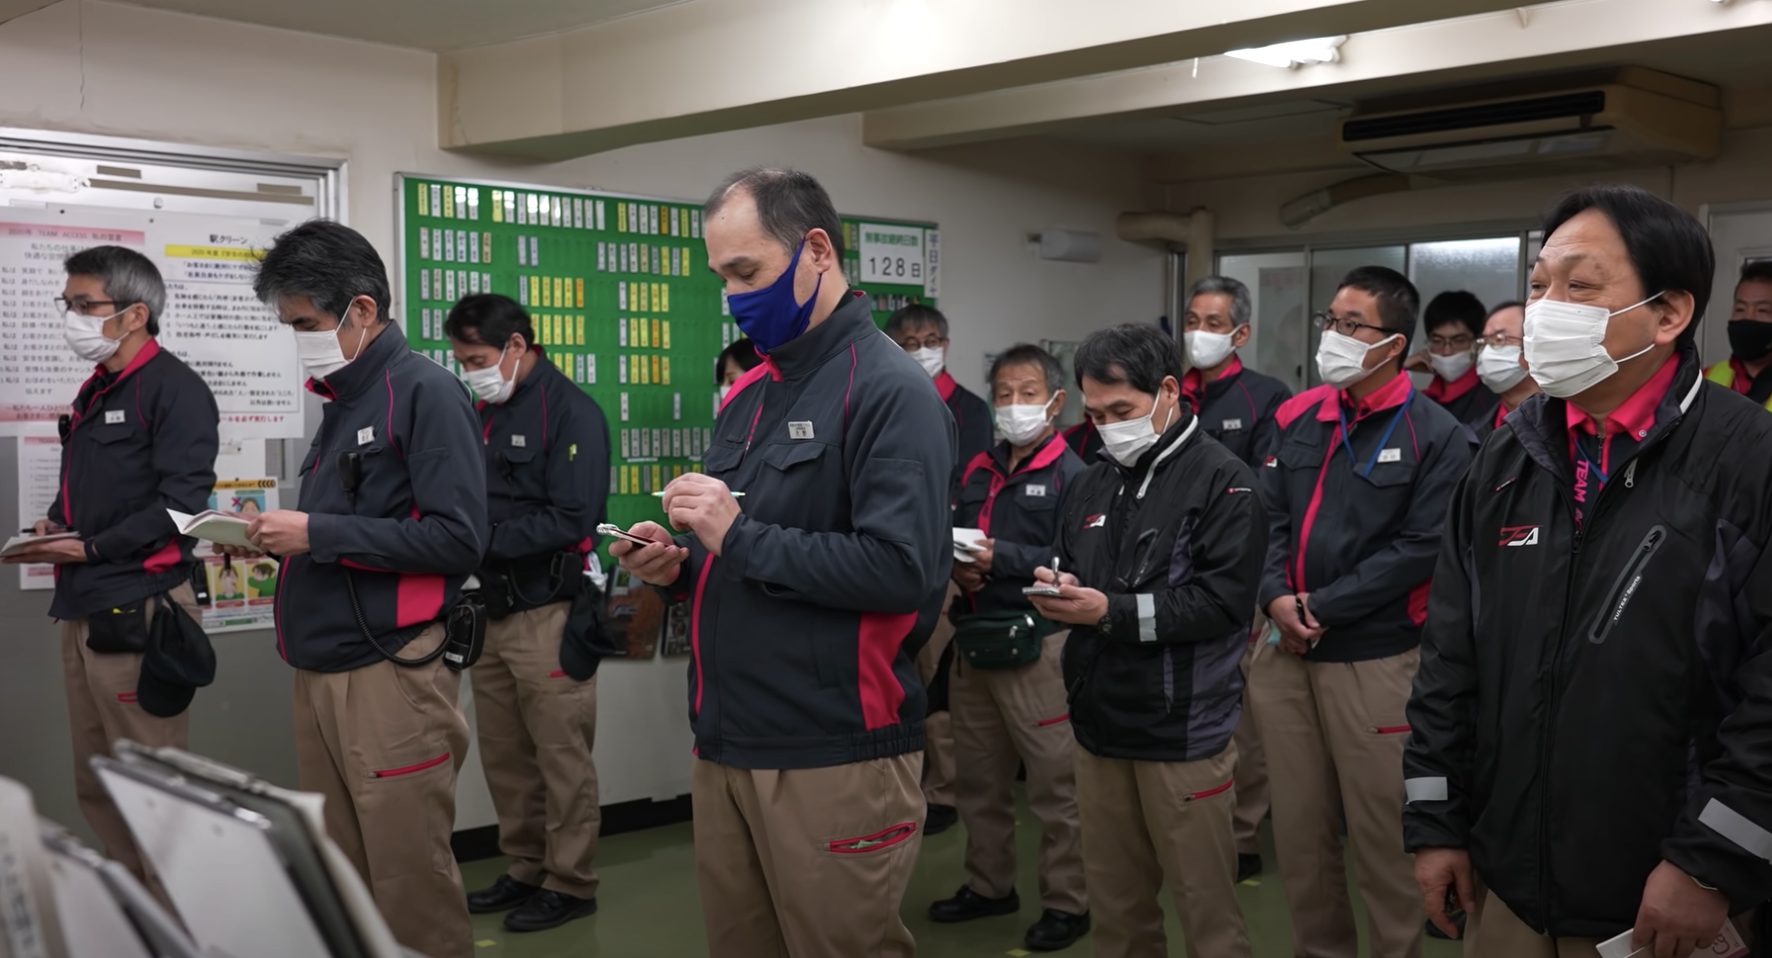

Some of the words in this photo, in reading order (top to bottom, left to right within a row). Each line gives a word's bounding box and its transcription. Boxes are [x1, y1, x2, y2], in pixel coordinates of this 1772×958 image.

[209, 234, 249, 245] 駅クリーン
[929, 233, 939, 296] 平日ダイヤ
[1574, 459, 1590, 504] TEAM
